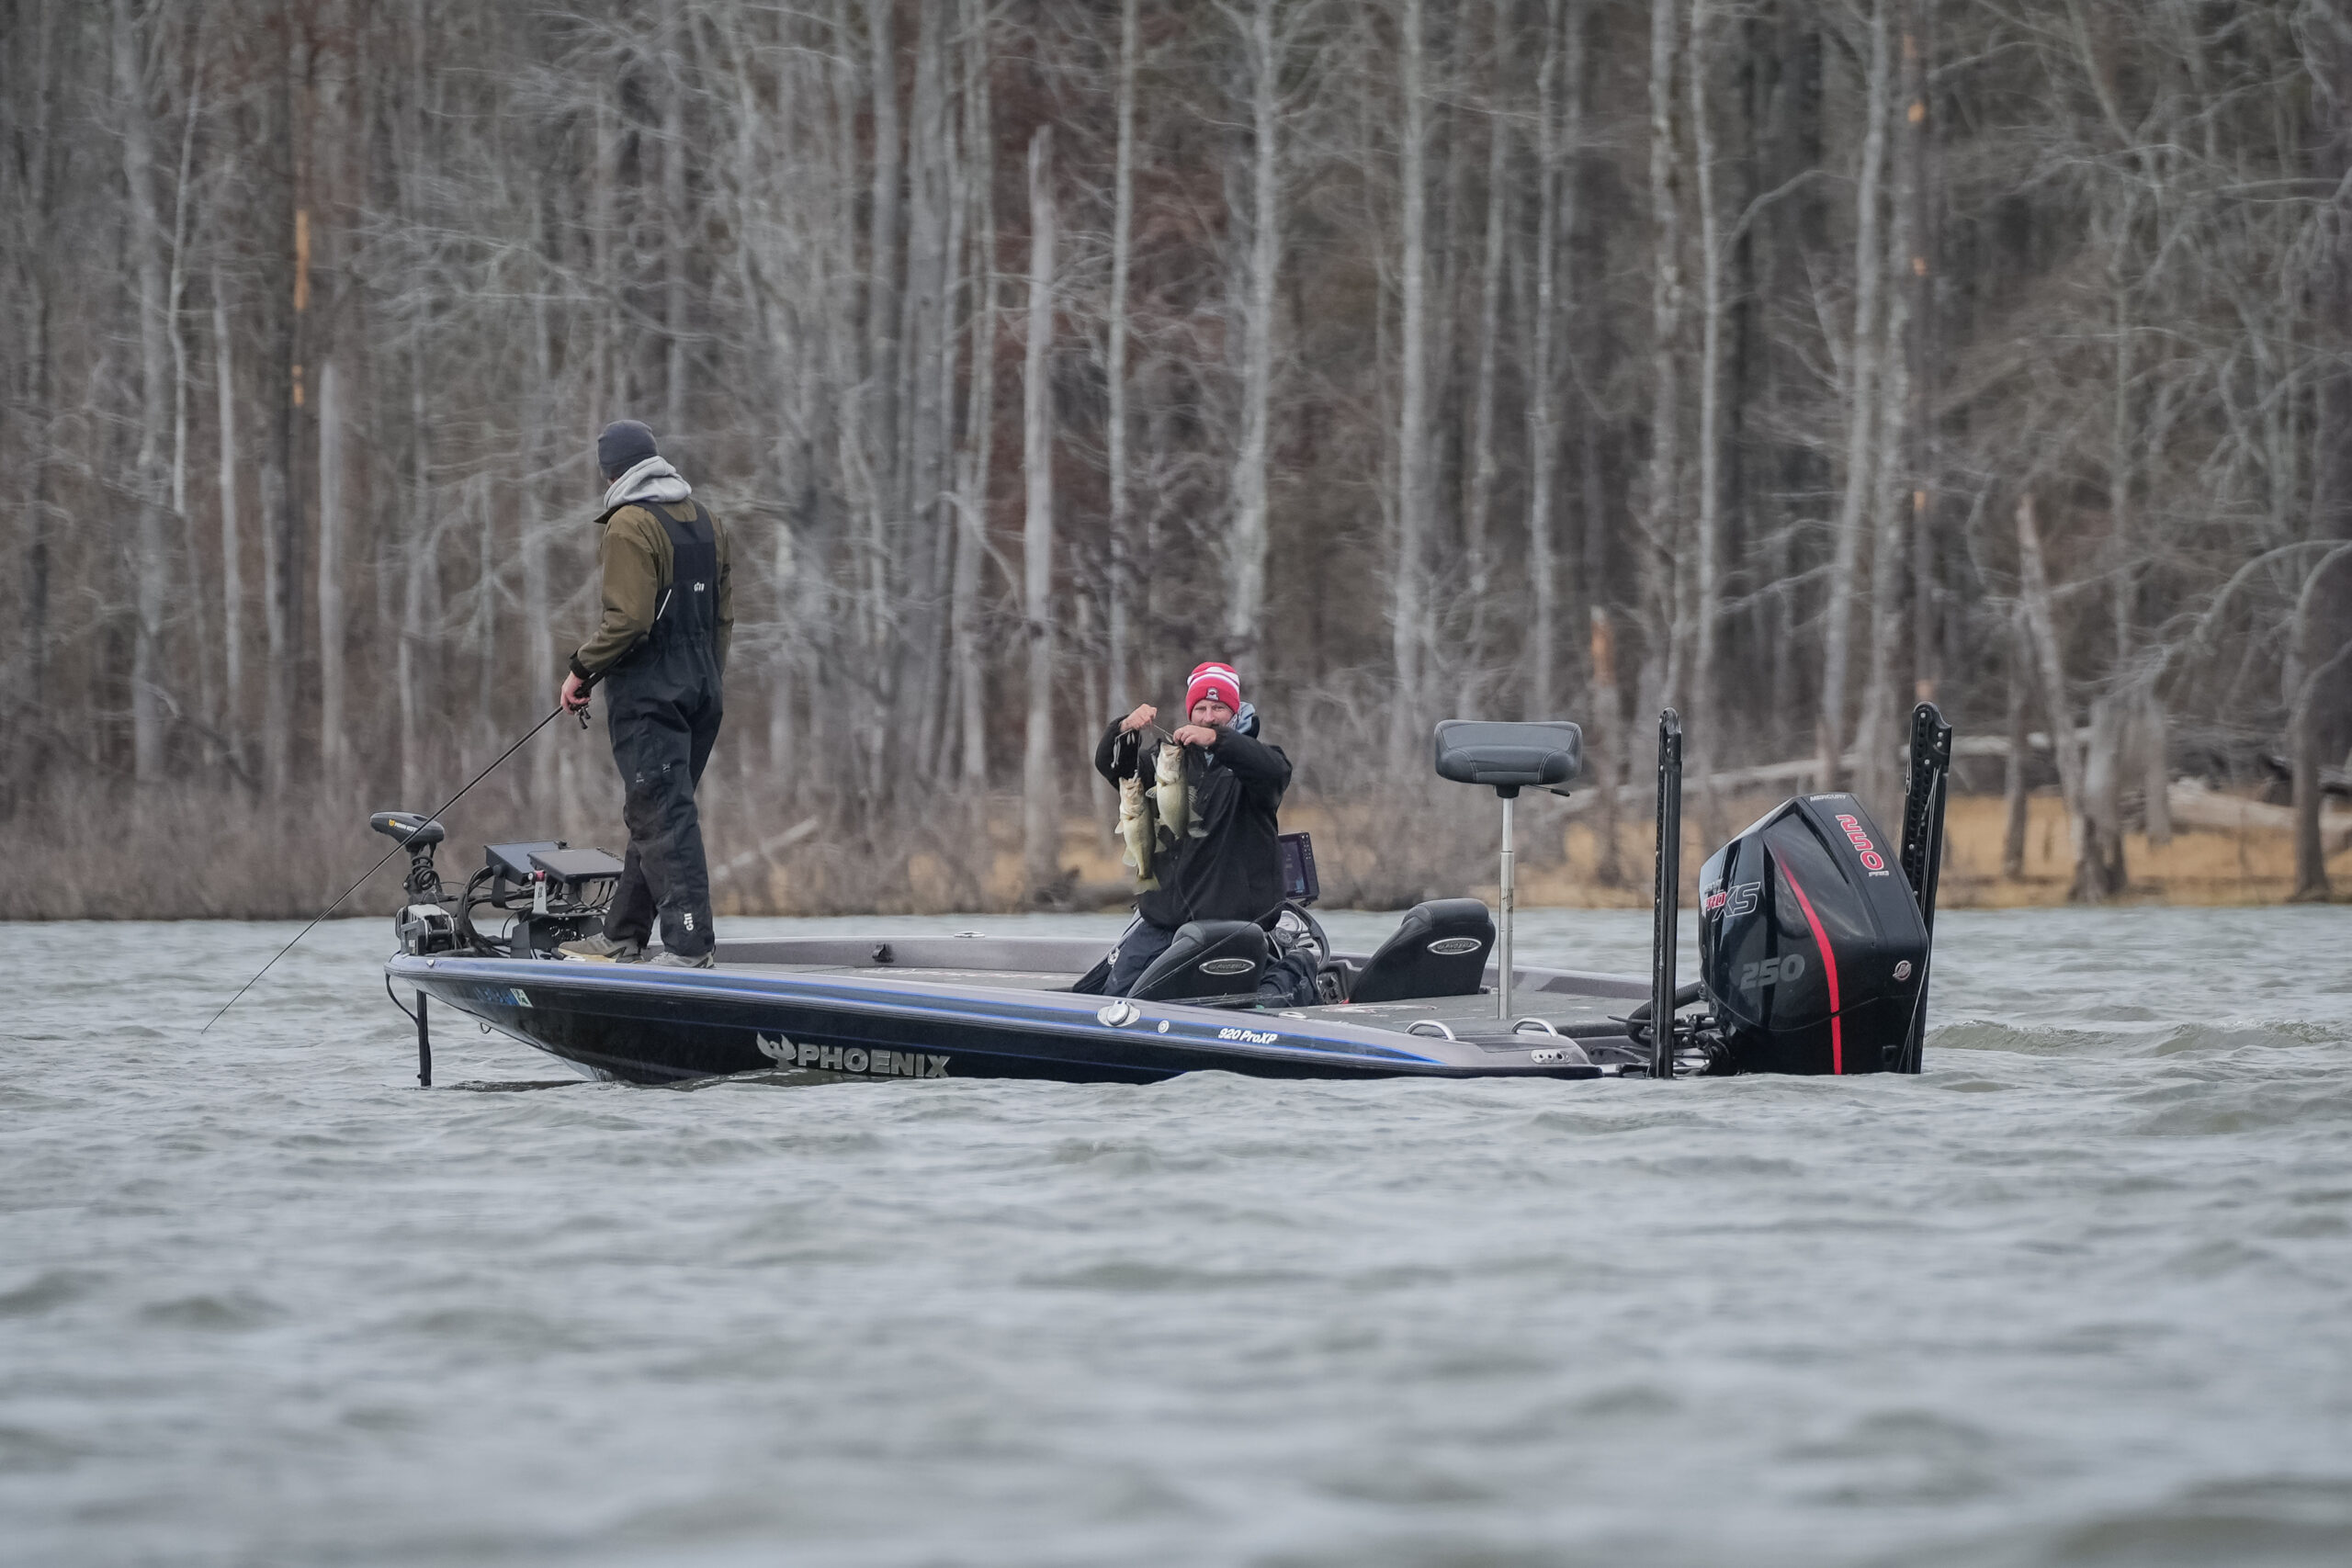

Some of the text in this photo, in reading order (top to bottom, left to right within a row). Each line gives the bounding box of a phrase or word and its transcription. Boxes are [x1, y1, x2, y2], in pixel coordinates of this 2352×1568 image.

[1836, 814, 1884, 871] 250
[684, 912, 694, 931] Gill
[1740, 953, 1805, 989] 250
[1218, 1028, 1278, 1044] 920 ProXP
[797, 1043, 951, 1077] PHOENIX
